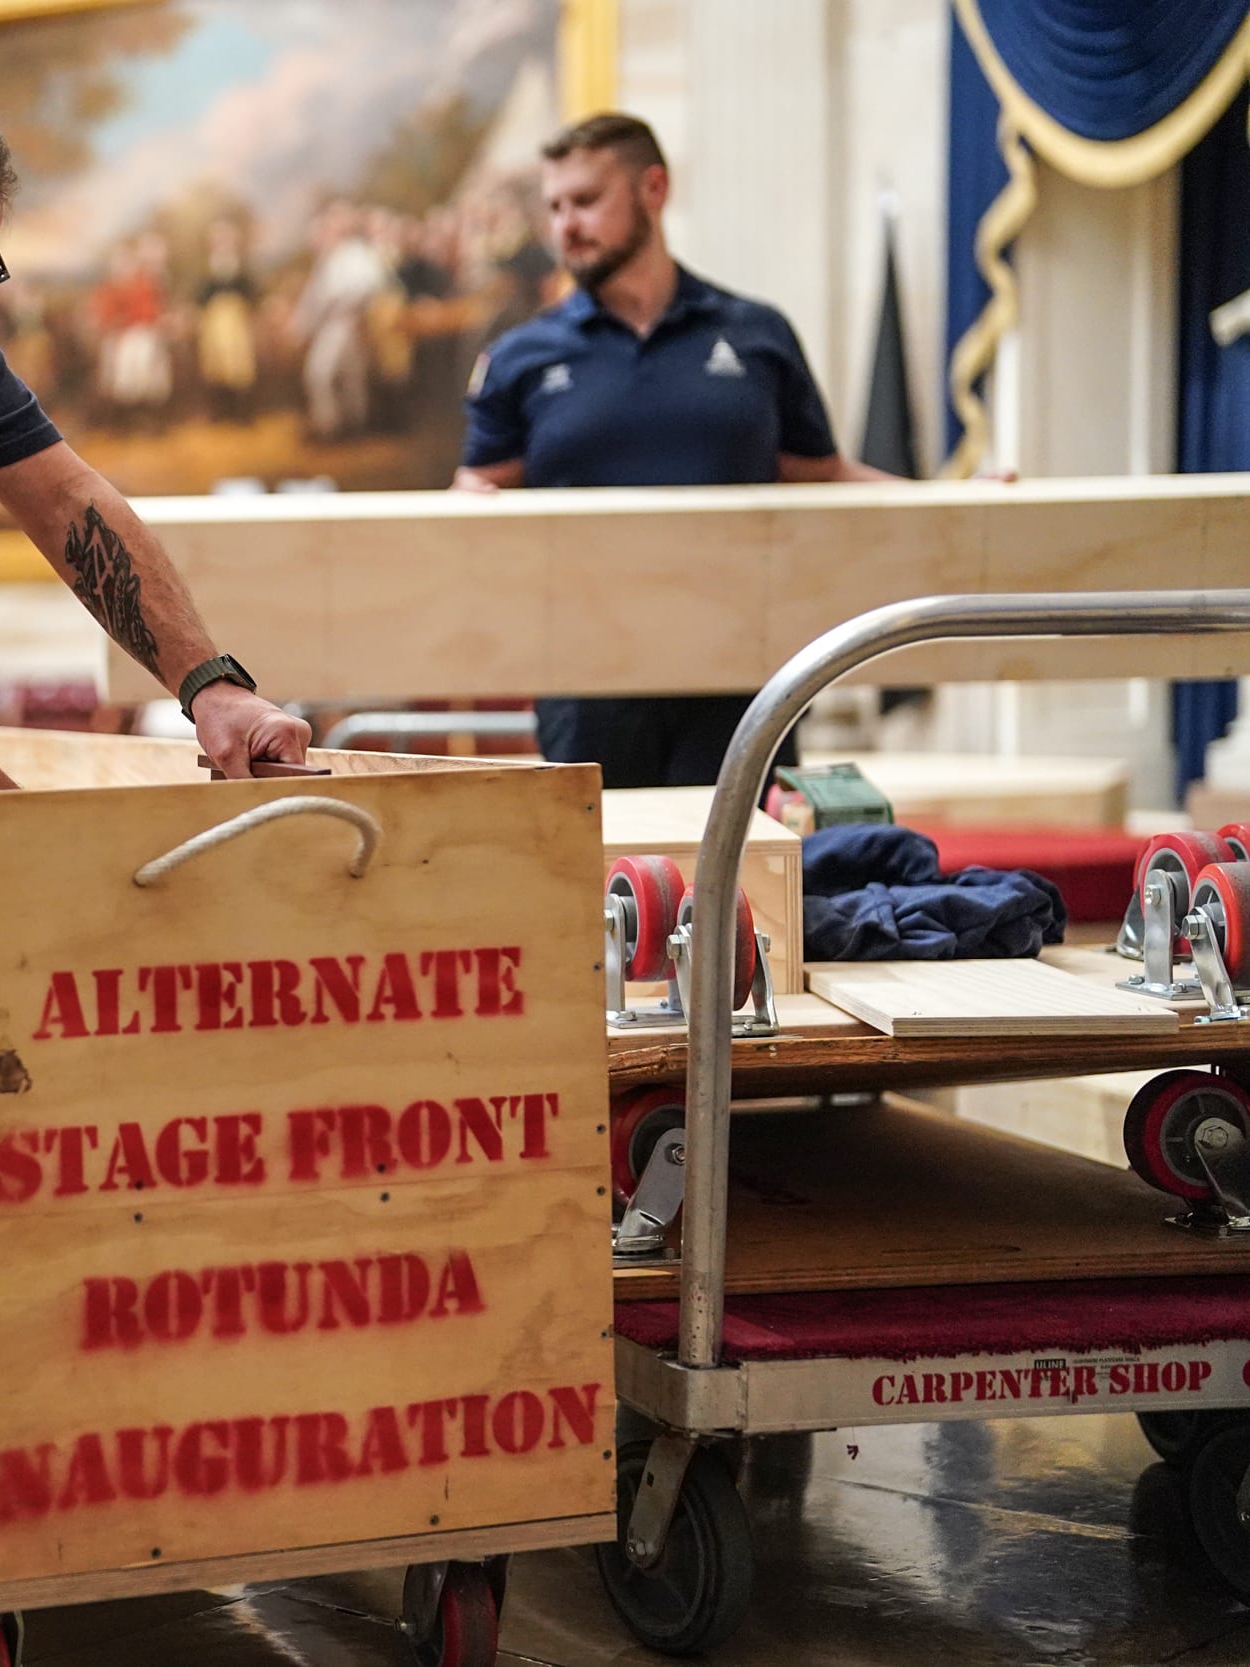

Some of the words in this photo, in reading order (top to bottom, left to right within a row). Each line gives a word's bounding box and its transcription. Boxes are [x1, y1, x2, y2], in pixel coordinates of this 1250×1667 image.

[32, 946, 524, 1041] ALTERNATE
[286, 1092, 559, 1183] FRONT
[78, 1250, 487, 1353] ROTUNDA
[872, 1366, 1098, 1405] CARPENTER
[1109, 1360, 1212, 1394] SHOP
